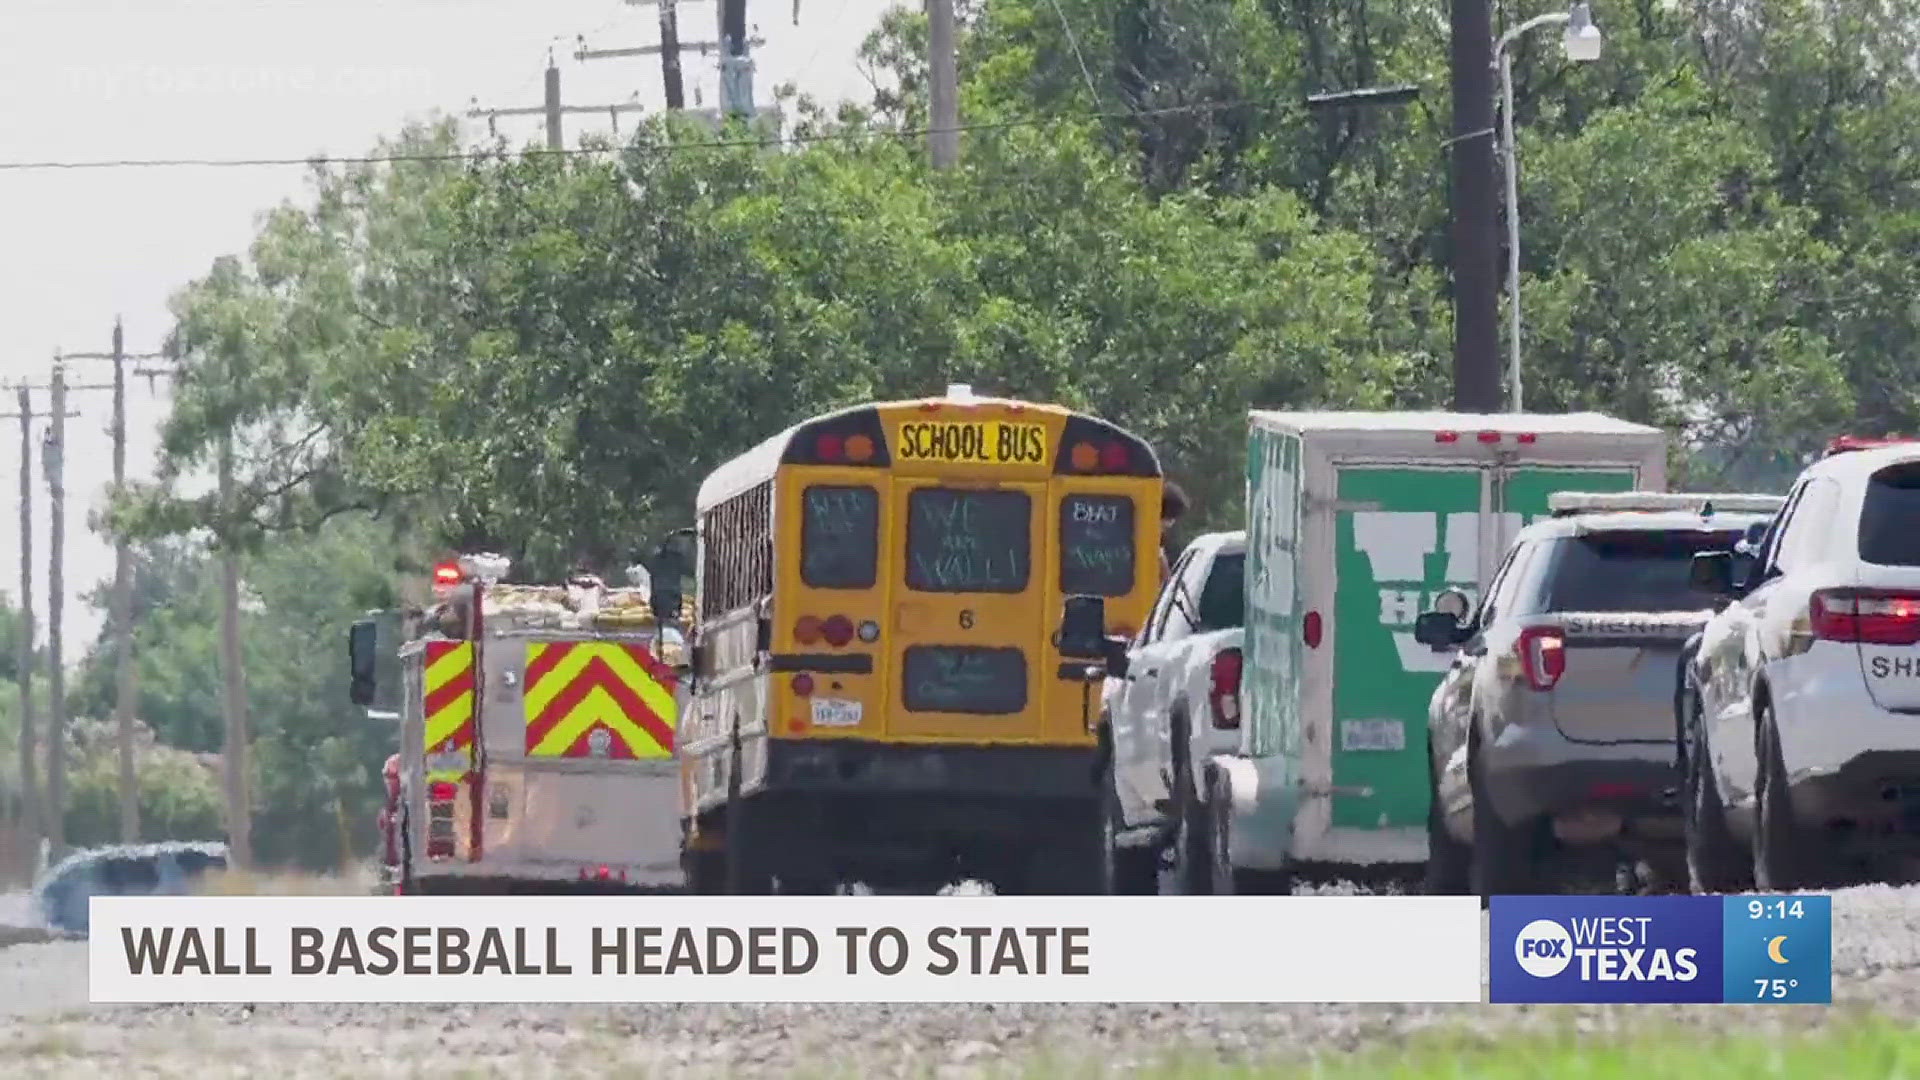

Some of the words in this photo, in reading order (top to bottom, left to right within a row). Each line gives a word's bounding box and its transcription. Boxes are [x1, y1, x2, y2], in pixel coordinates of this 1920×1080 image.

[901, 423, 988, 460] SCHOOL
[997, 425, 1043, 462] BUS
[959, 610, 974, 630] 6
